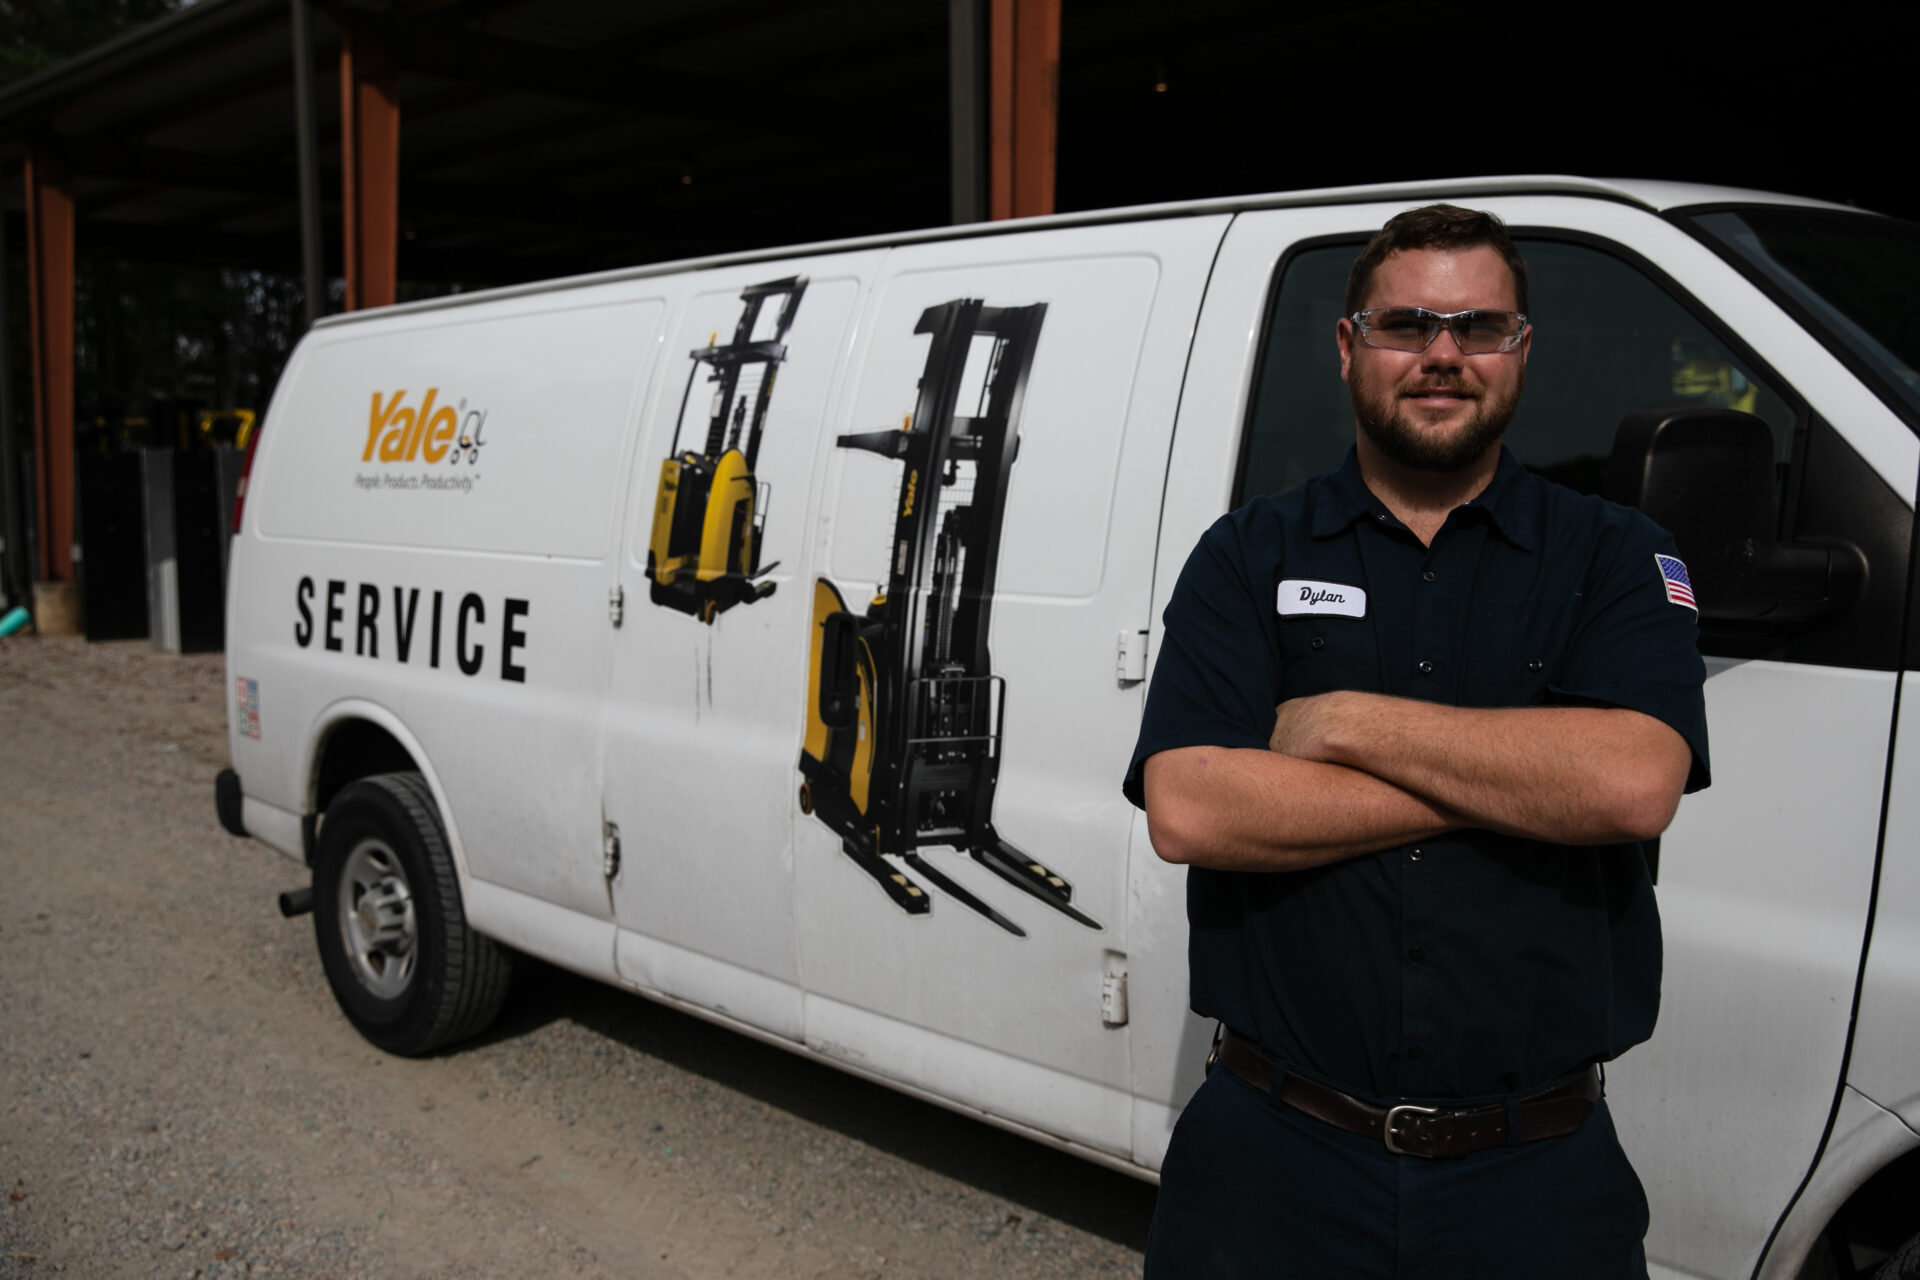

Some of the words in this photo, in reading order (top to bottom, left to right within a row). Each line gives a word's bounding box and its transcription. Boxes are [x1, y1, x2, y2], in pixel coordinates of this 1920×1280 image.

[361, 387, 457, 465] Yale
[295, 575, 529, 684] SERVICE
[1299, 586, 1346, 606] Dylan
